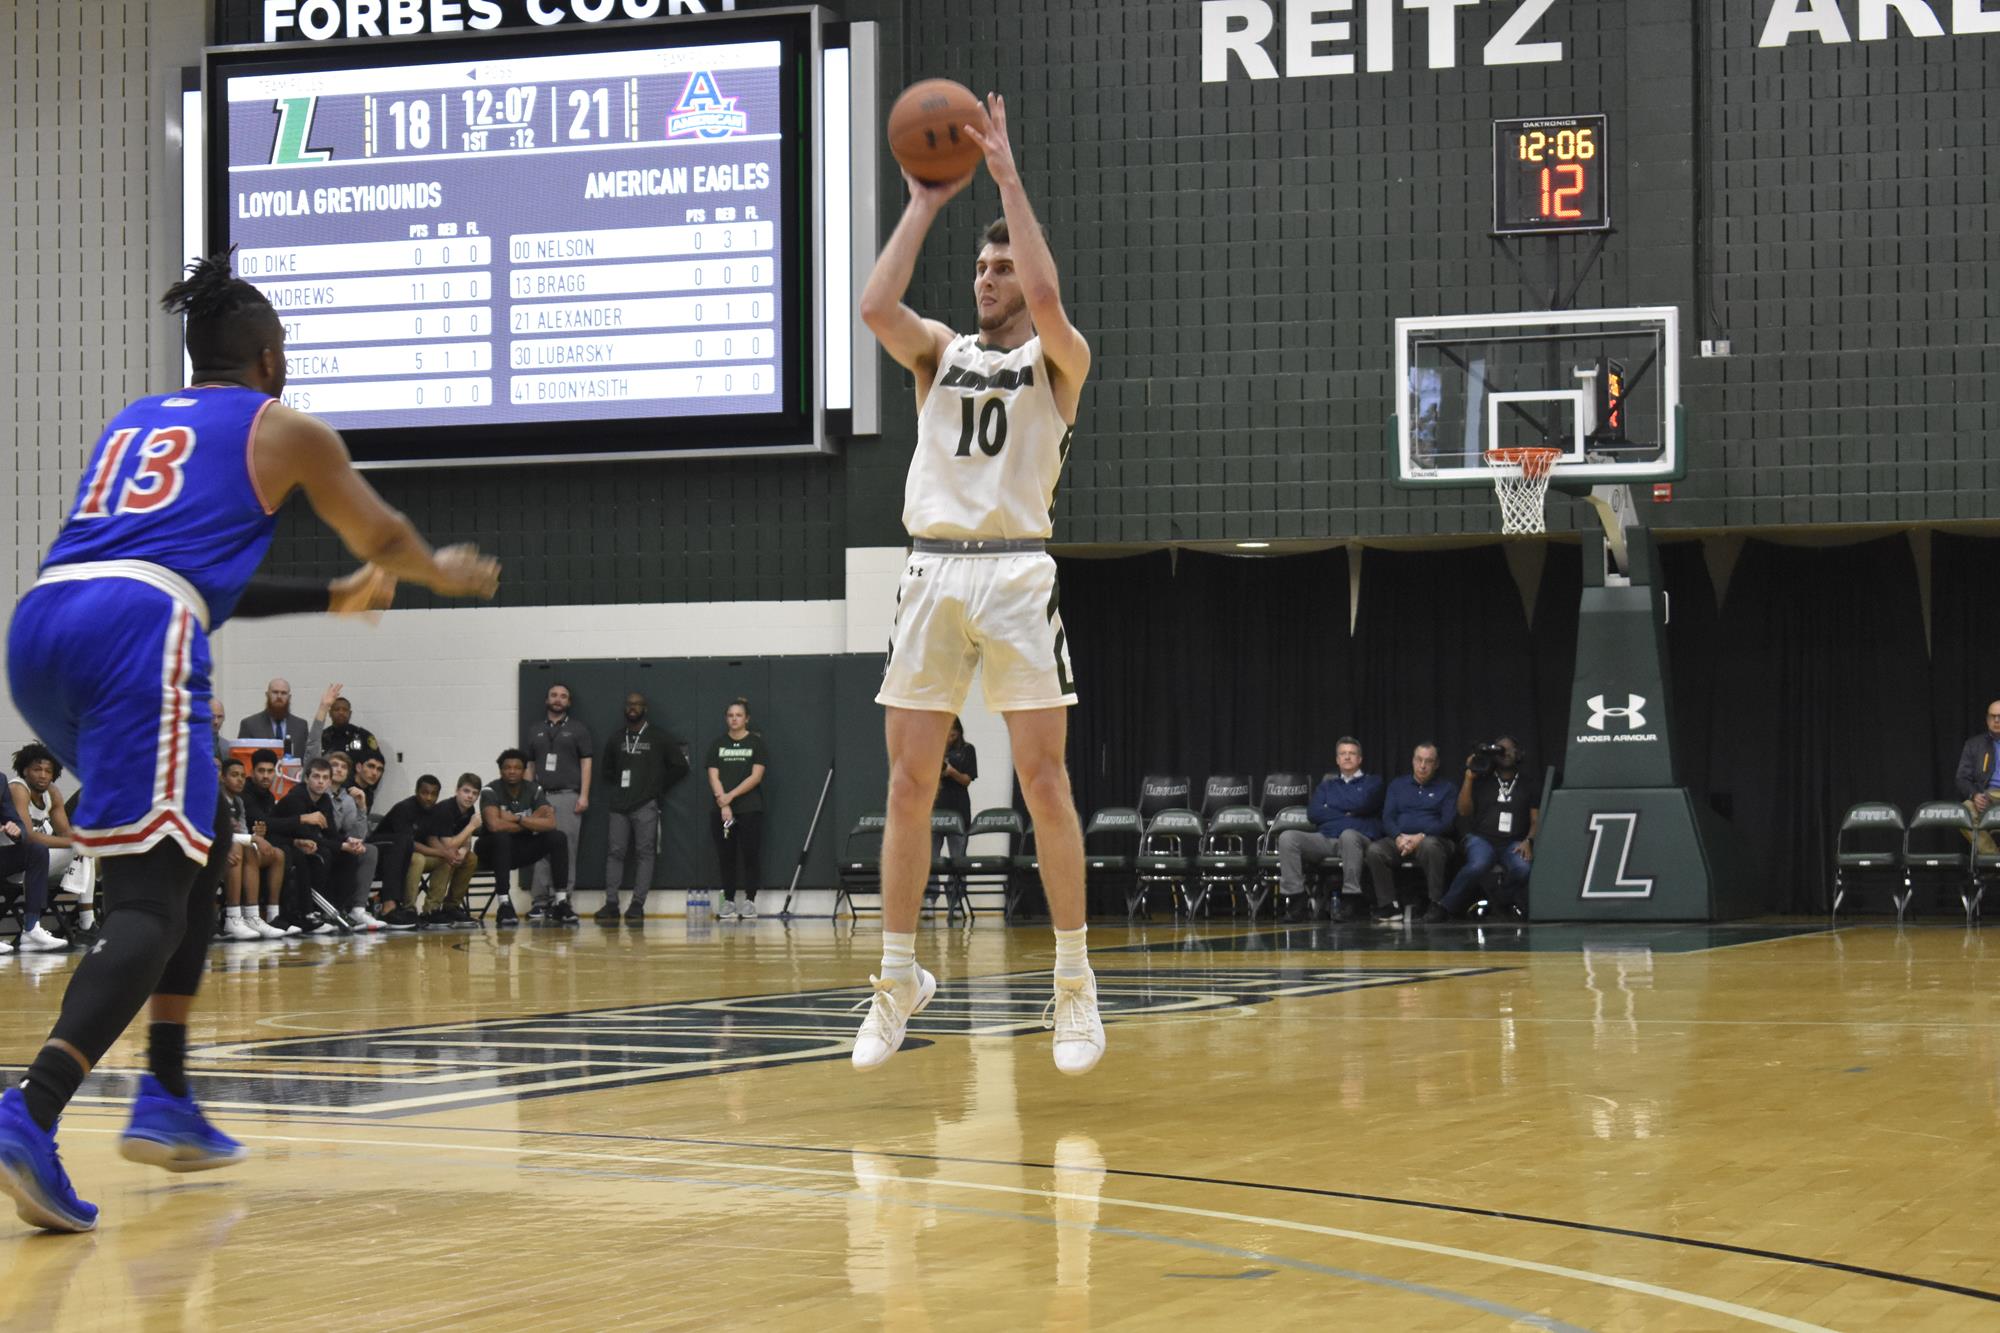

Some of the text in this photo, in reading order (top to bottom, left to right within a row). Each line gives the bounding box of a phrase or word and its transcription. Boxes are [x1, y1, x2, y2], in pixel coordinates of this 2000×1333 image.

[264, 0, 736, 42] FORBES COU
[1202, 0, 1562, 82] REITZ
[462, 86, 537, 125] 12:07
[568, 88, 609, 139] 21
[389, 100, 430, 150] 18
[1522, 120, 1577, 128] DAKTRONICS
[462, 128, 535, 151] 1ST :12
[1519, 129, 1594, 161] 12:06
[584, 162, 769, 199] AMERICAN EAGLES
[1540, 163, 1584, 218] 12
[238, 182, 442, 218] LOYOLA GREYHOUNDS
[685, 208, 706, 223] PTS
[409, 224, 428, 238] PTS
[466, 221, 479, 235] FL
[694, 229, 758, 250] 0 3 1
[414, 245, 477, 266] 0 0 0
[514, 238, 594, 259] 00 NELSON
[242, 253, 297, 274] 00 DIKE
[516, 274, 585, 295] 13 BRAGG
[694, 264, 759, 286] 0 0 0
[266, 287, 335, 307] ANDREWS
[411, 280, 477, 301] 11 0 0
[515, 308, 622, 330] 21 ALEXANDER
[694, 301, 759, 322] 0 1 0
[285, 322, 301, 341] RT
[415, 314, 477, 335] 0 0 0
[515, 344, 614, 365] 30 LUBARSKY
[695, 336, 759, 357] 0 0 0
[286, 356, 340, 376] STECKA
[415, 350, 477, 370] 5 1 1
[515, 379, 628, 401] 41 BOONYASITH
[696, 372, 760, 393] 7 0 0
[282, 392, 311, 410] NES
[416, 384, 479, 405] 0 0 0
[954, 396, 1008, 457] 10
[73, 425, 197, 520] 13
[1577, 733, 1657, 743] UNDER ARMOUR
[1918, 808, 1966, 819] LOYOLA
[1580, 812, 1654, 899] L
